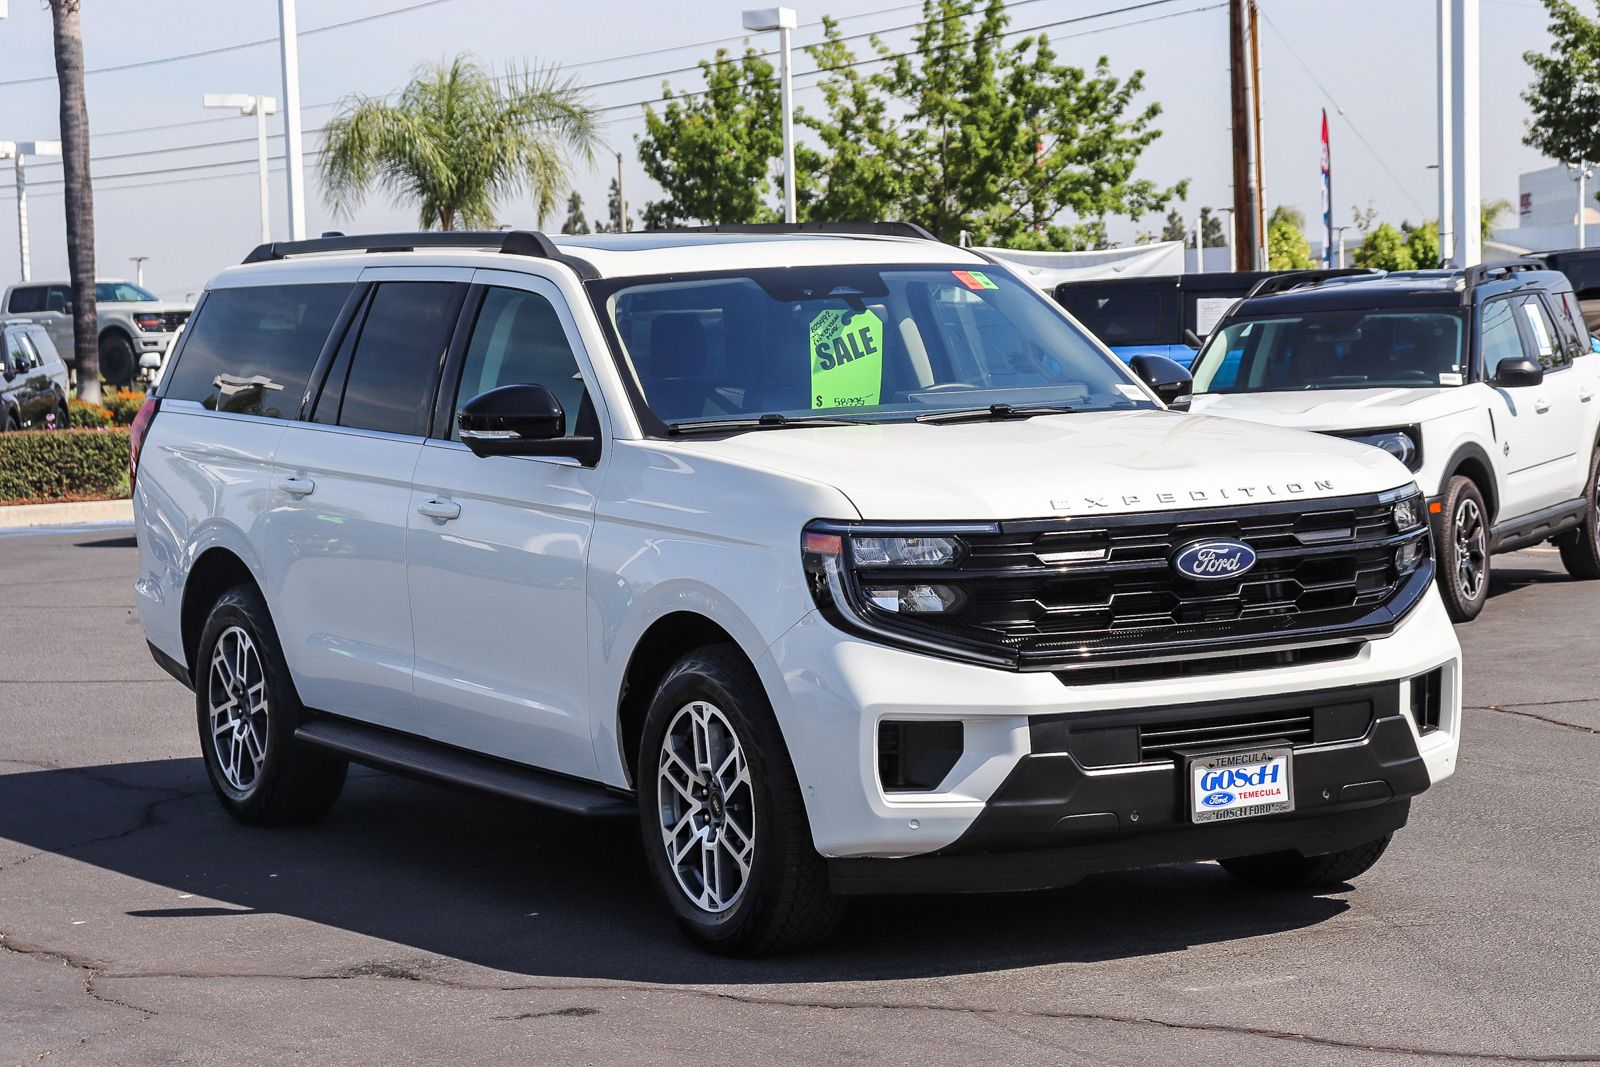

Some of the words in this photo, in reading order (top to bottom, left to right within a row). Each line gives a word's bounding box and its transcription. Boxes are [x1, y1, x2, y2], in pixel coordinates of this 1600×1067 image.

[815, 326, 878, 371] SALE
[816, 395, 823, 408] $
[1050, 480, 1335, 511] EXPEDITION
[1193, 548, 1240, 573] Ford
[1215, 752, 1267, 768] TEMECULA
[1209, 794, 1230, 805] Ford
[1238, 788, 1281, 800] TEMECULA
[1249, 805, 1271, 816] FORD
